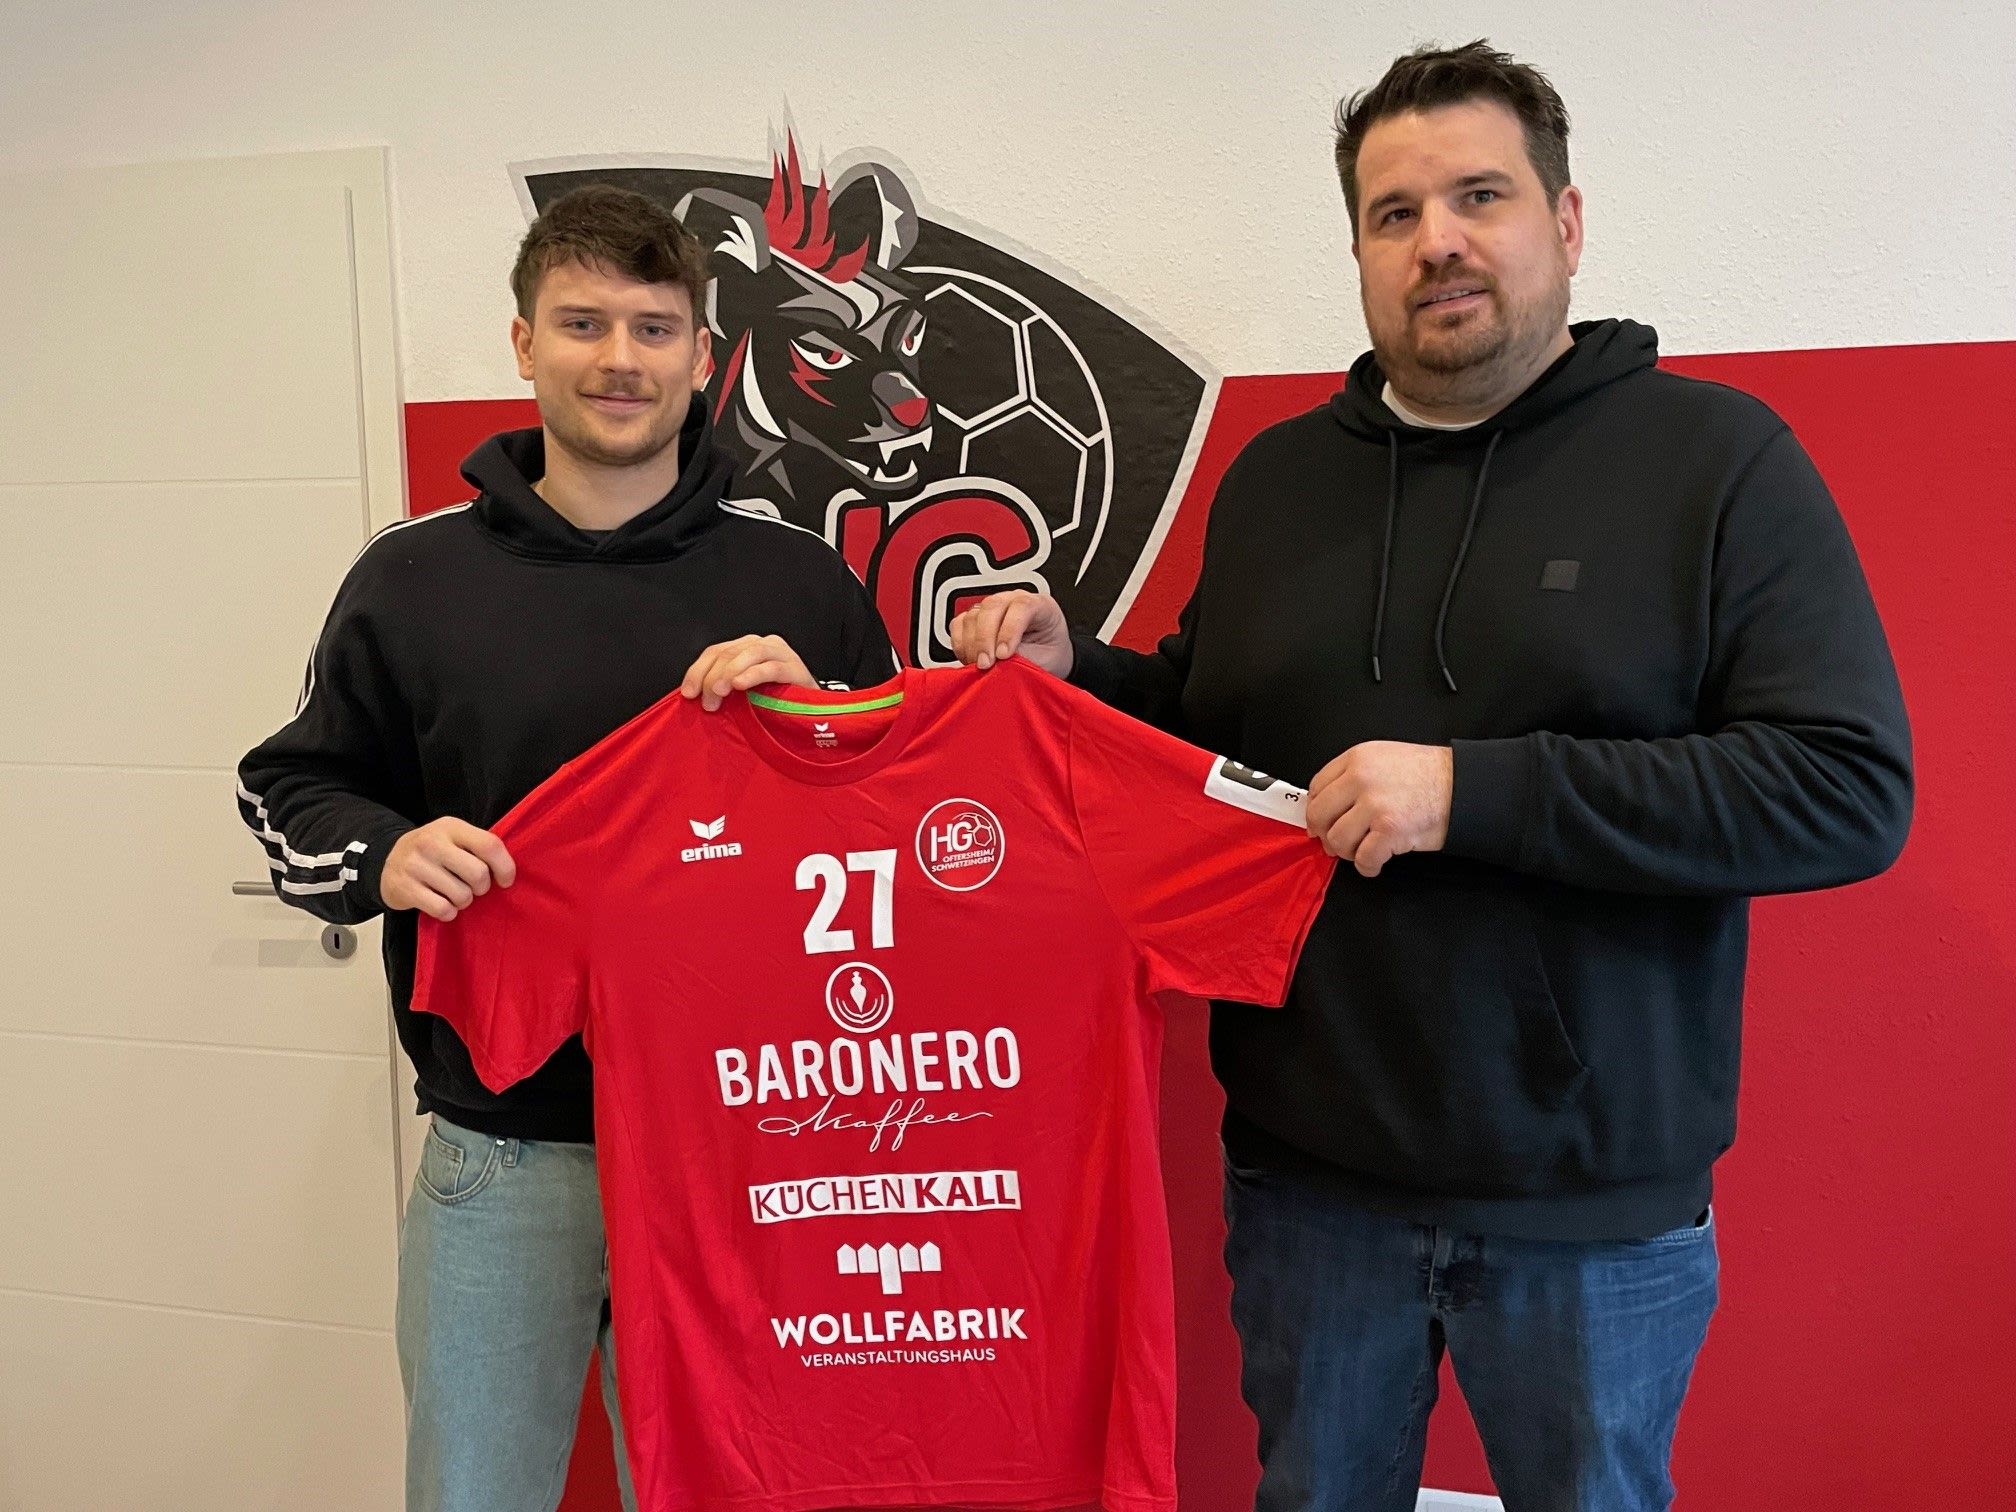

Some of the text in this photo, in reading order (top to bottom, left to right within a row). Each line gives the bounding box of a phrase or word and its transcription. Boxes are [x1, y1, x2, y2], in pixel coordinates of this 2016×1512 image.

[1285, 792, 1301, 802] 3.
[681, 841, 742, 862] erima
[930, 821, 973, 862] HG
[931, 855, 995, 873] SCHWETZINGEN
[795, 849, 897, 954] 27
[715, 1027, 1021, 1107] BARONERO
[755, 1174, 1016, 1220] KÜCHEN KALL
[770, 1307, 1028, 1349] WOLLFABRIK
[801, 1348, 996, 1368] VERANSTALTUNGSHAUS
